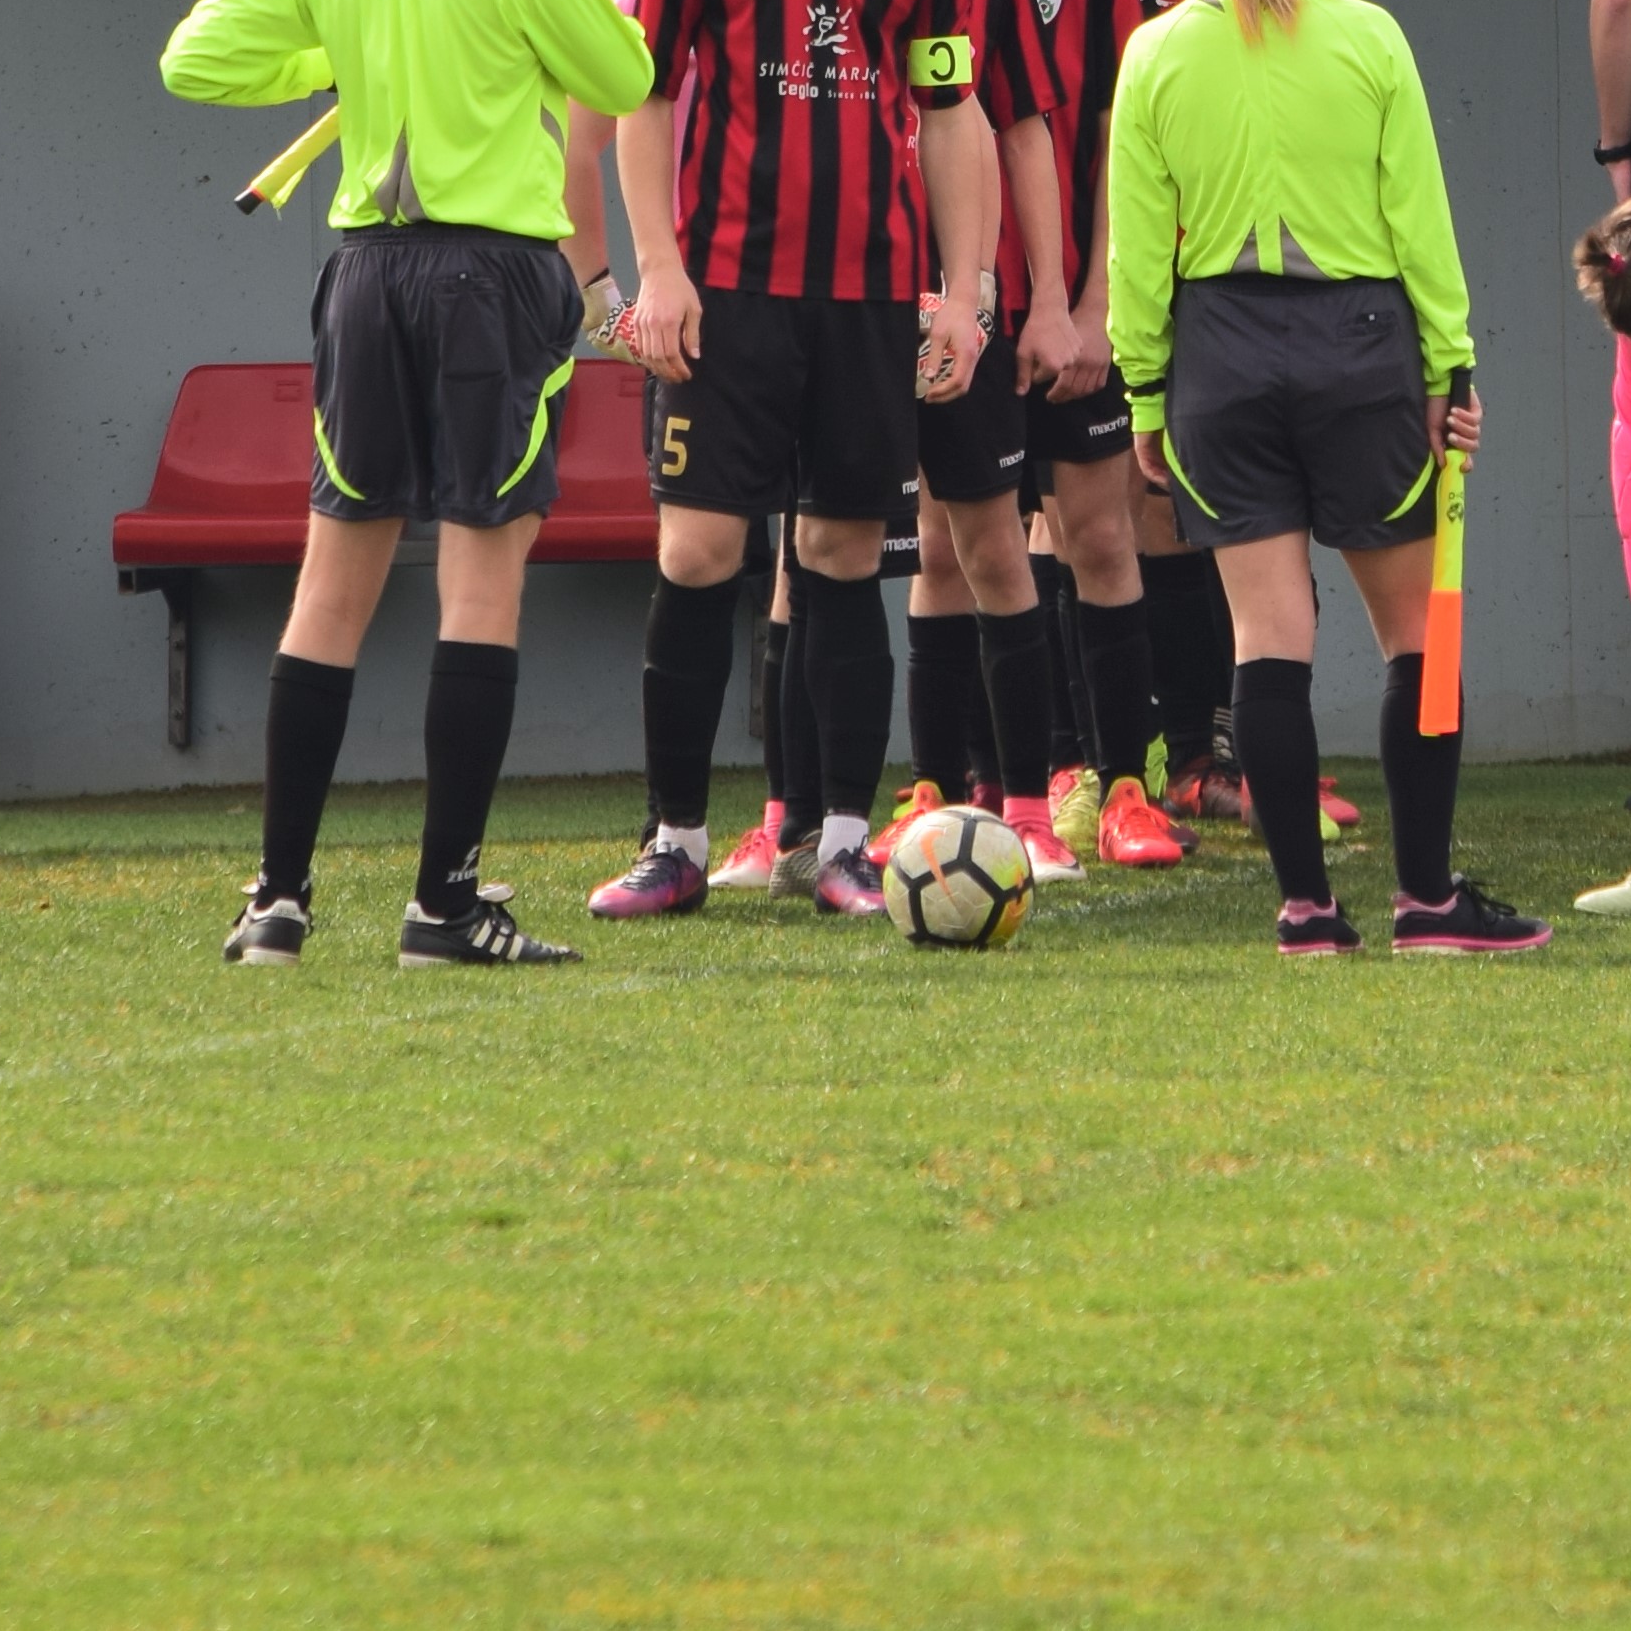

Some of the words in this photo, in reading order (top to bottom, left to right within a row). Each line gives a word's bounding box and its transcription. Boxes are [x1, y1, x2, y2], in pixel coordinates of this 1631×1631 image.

[778, 80, 819, 100] Ceglo
[661, 416, 691, 478] 5
[883, 536, 920, 552] macr
